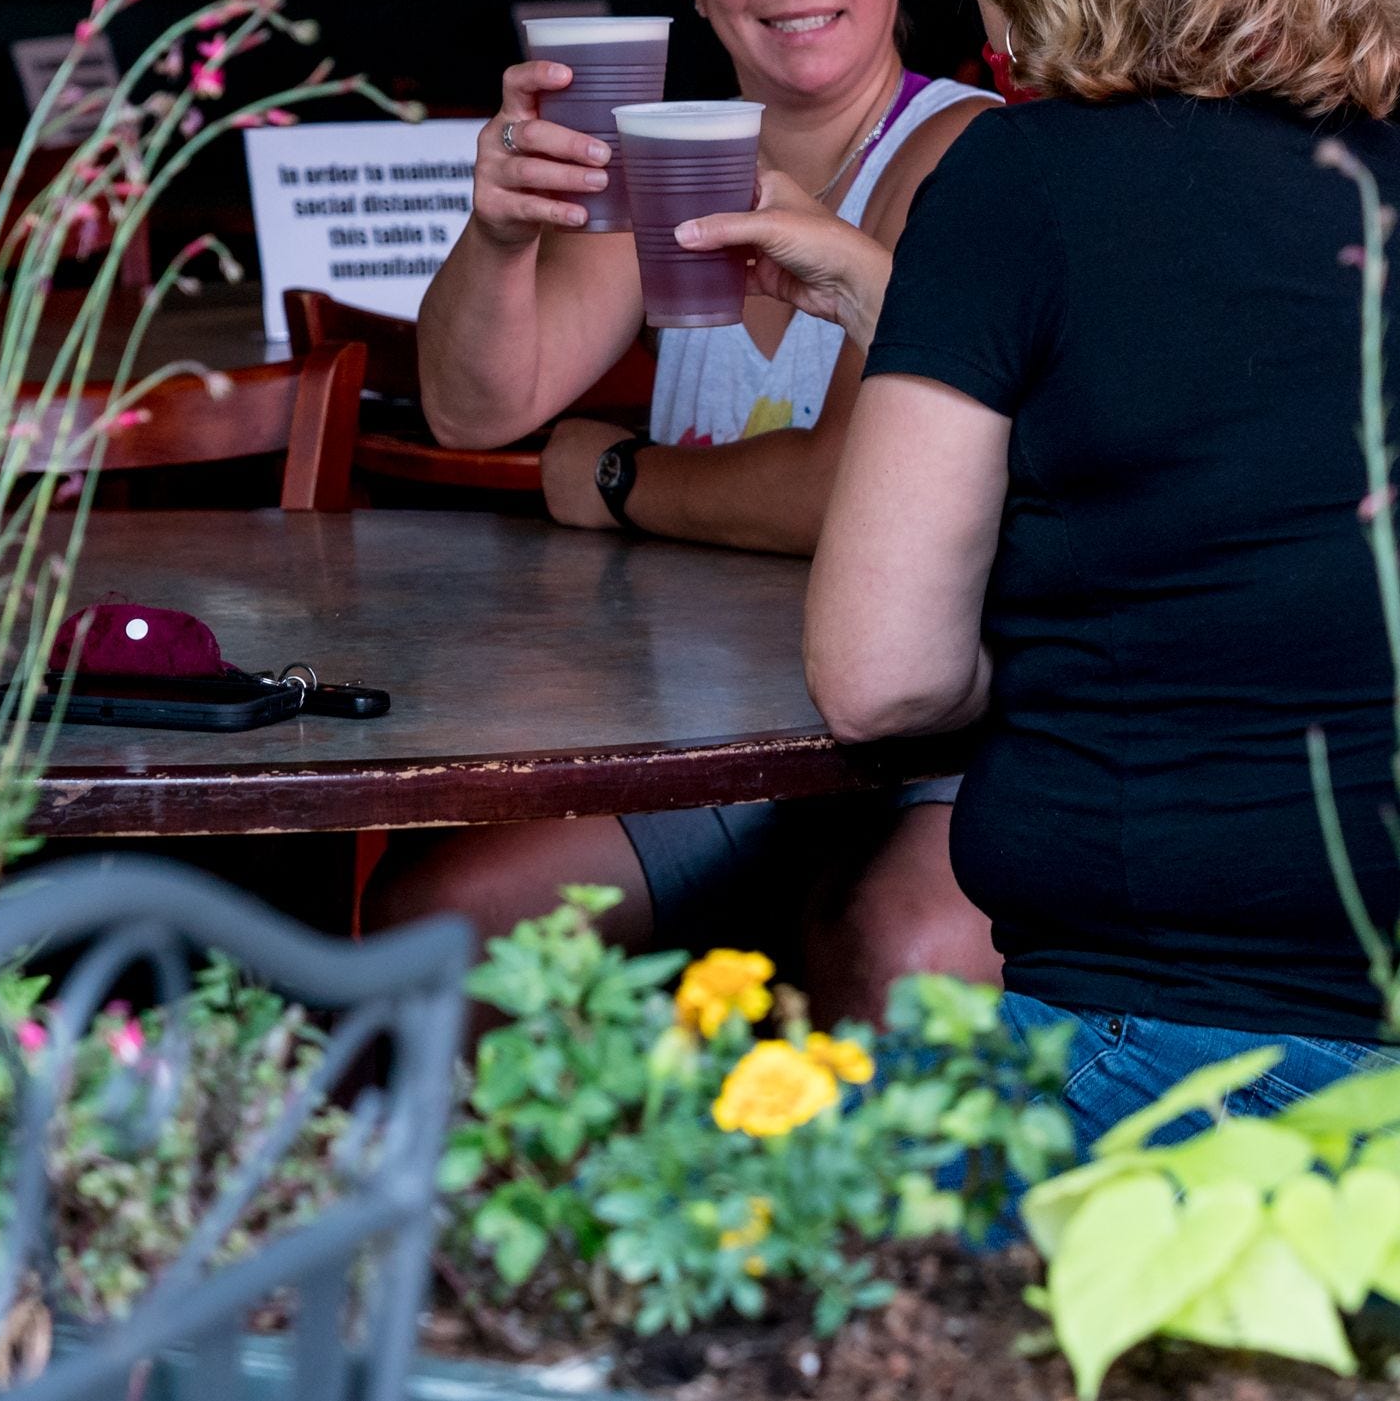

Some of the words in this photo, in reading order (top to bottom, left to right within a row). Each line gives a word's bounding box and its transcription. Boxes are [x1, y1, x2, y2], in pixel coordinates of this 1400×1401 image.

[304, 162, 358, 184] order
[364, 162, 383, 183] to
[294, 197, 355, 216] social
[329, 226, 366, 248] this
[373, 224, 425, 245] table
[429, 224, 448, 245] is
